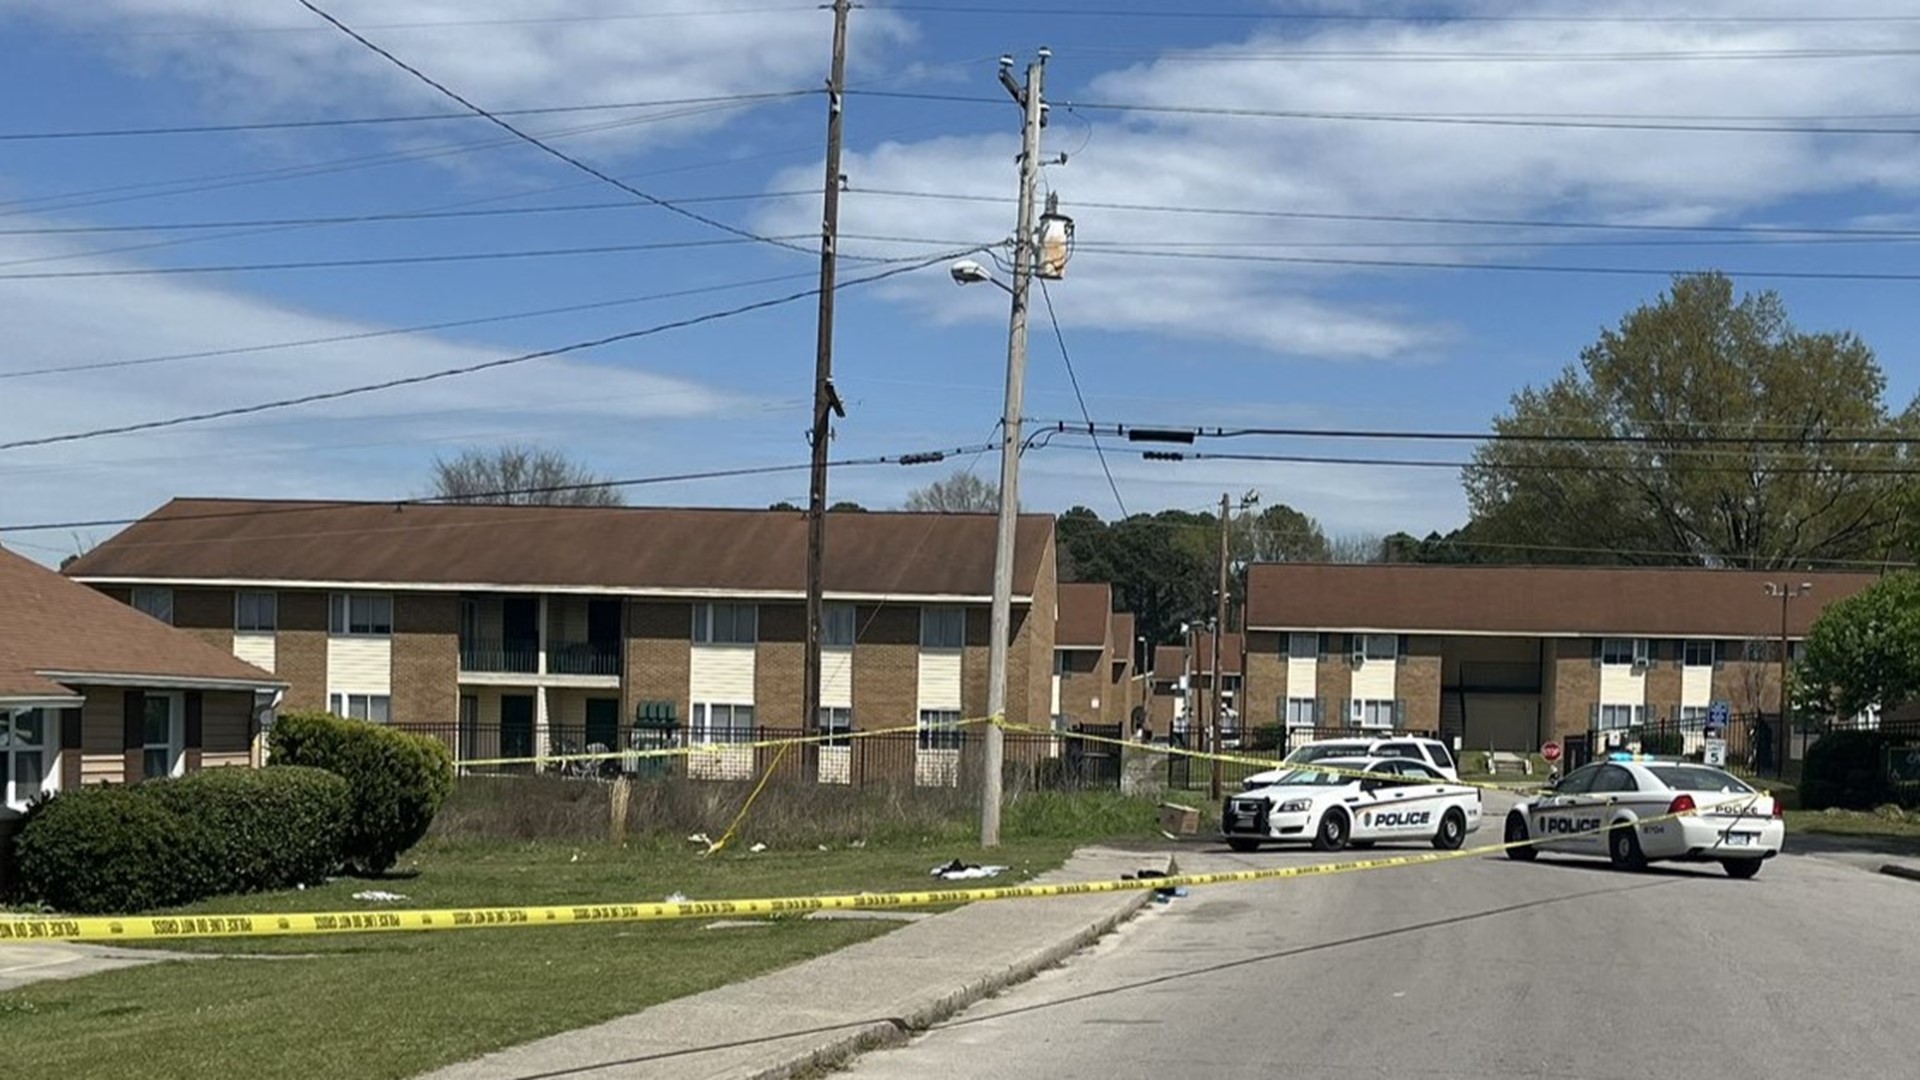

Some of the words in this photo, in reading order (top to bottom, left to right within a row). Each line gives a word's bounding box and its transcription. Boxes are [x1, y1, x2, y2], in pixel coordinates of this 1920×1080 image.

[1711, 752, 1719, 763] 5
[1715, 805, 1758, 815] POLICE
[1374, 811, 1431, 827] POLICE
[1548, 817, 1601, 834] POLICE
[14, 922, 28, 938] DO
[28, 922, 49, 938] LINE
[50, 921, 81, 938] POLICE
[152, 919, 179, 935] CROSS
[179, 920, 196, 934] NOT
[196, 919, 208, 934] DO
[208, 919, 226, 933] LINE
[227, 918, 253, 933] POLICE
